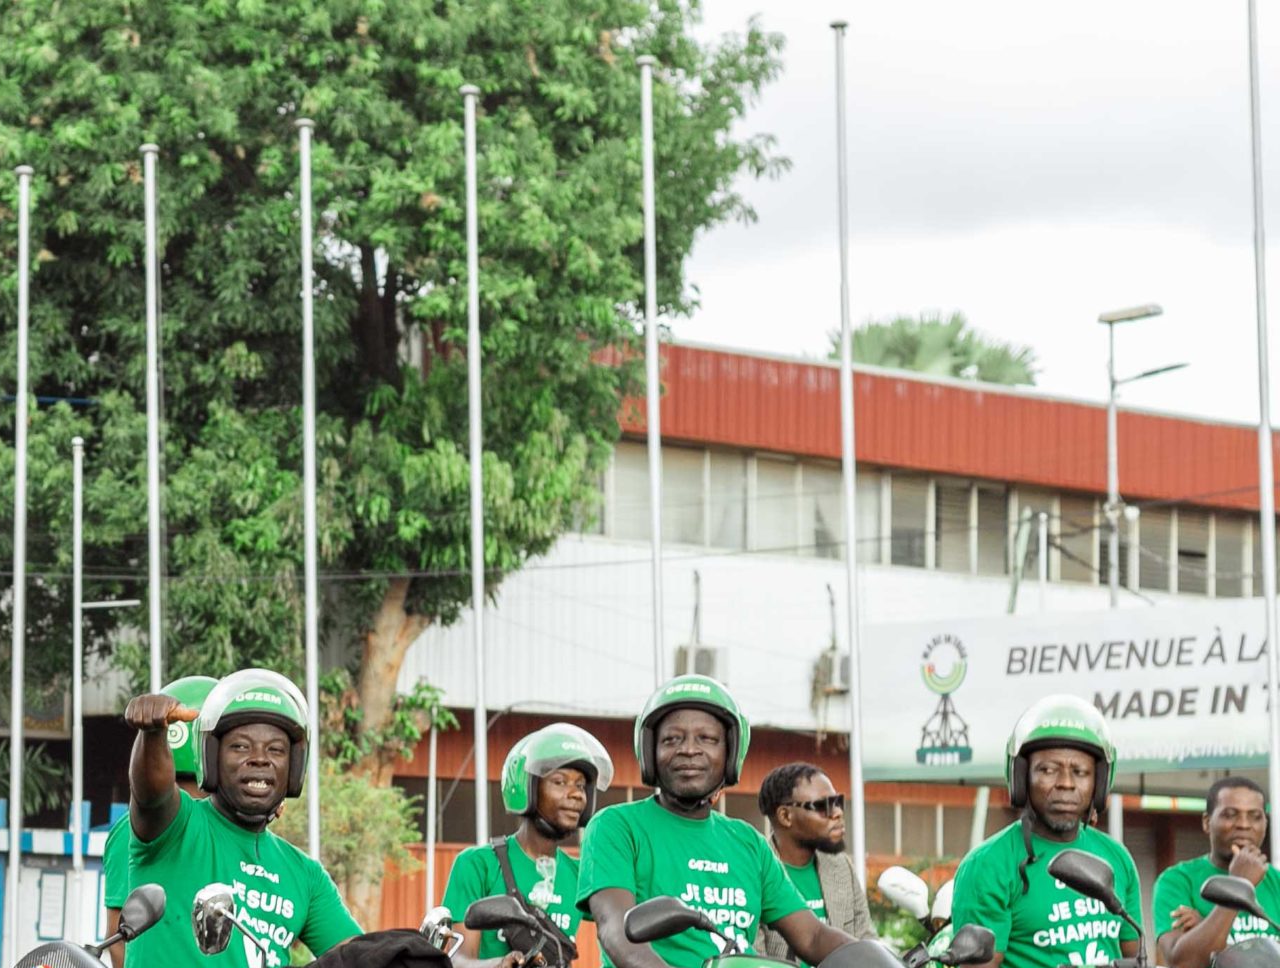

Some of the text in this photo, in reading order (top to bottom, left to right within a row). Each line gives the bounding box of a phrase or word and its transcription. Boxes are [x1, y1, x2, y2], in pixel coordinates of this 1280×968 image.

[1005, 636, 1198, 676] BIENVENUE
[1202, 626, 1227, 665] À
[1092, 687, 1199, 720] MADE
[1210, 684, 1249, 715] IN
[246, 889, 294, 919] SUIS
[703, 886, 747, 907] SUIS
[1048, 897, 1107, 922] JE SUI
[1033, 920, 1121, 947] CHAMPIO
